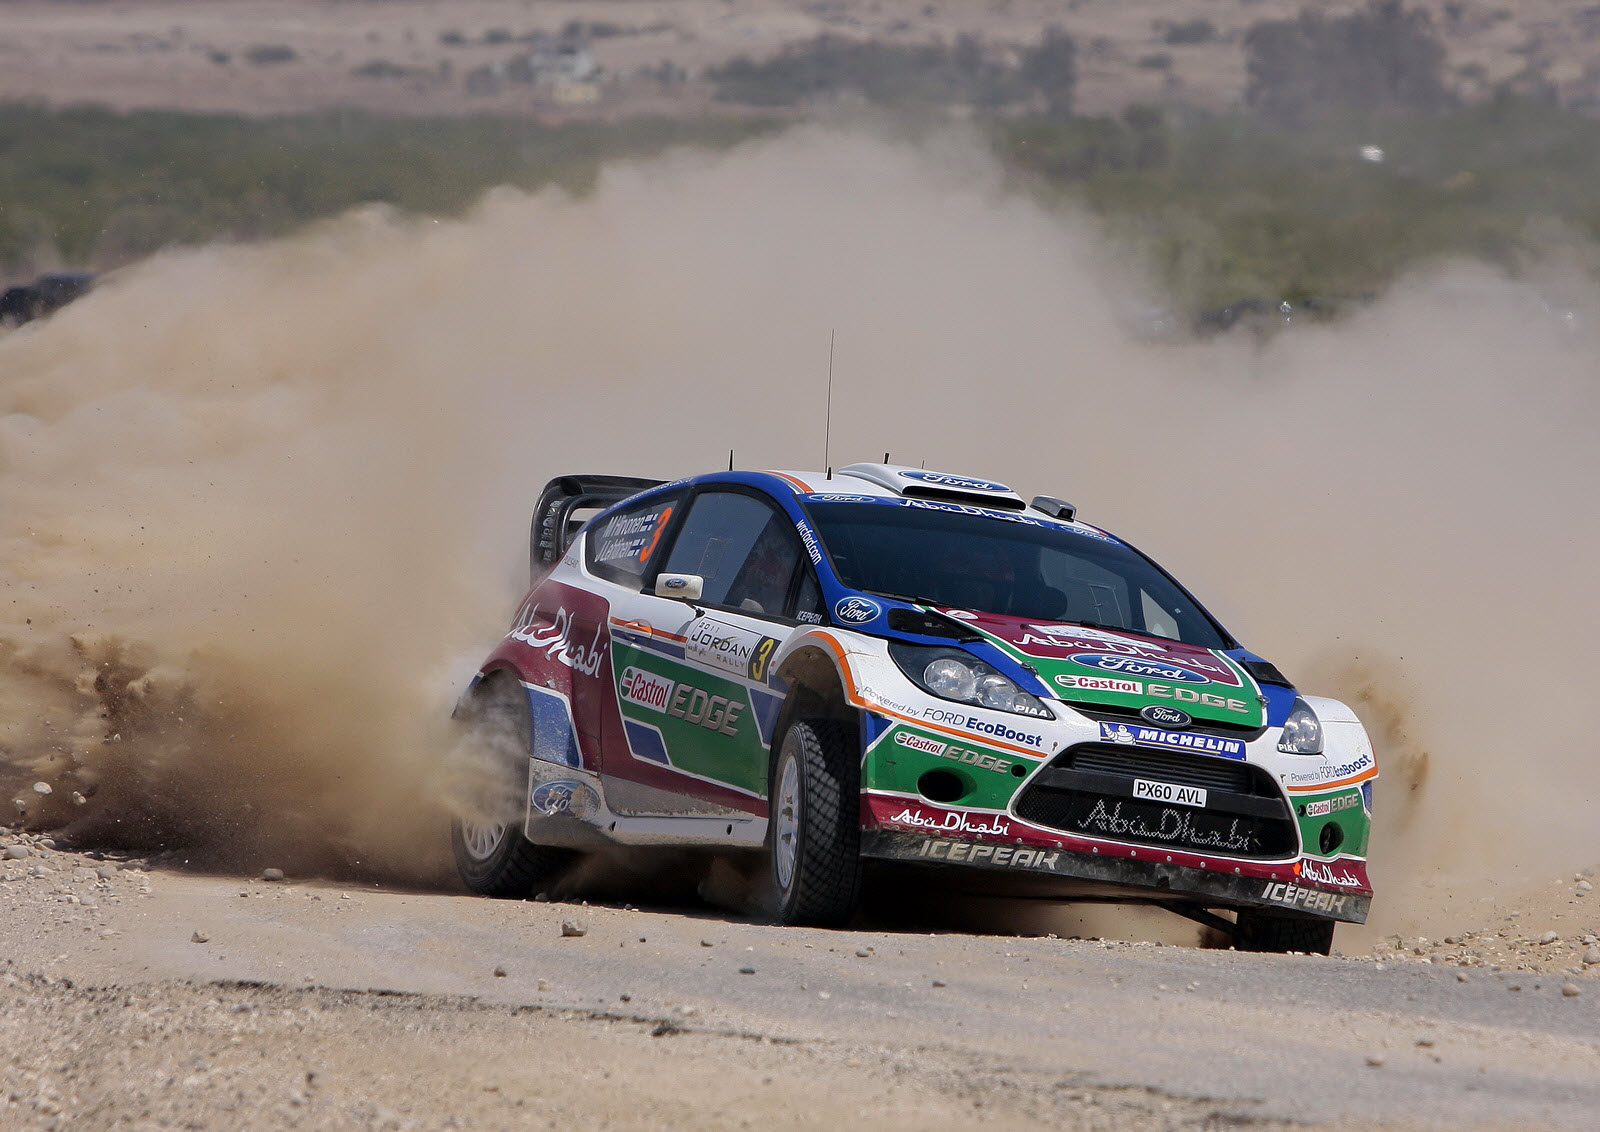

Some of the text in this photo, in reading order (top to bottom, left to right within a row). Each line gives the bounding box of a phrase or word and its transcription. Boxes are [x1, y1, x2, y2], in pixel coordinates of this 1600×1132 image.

[923, 472, 993, 490] Ford
[822, 494, 864, 502] Ford
[639, 507, 673, 563] 3
[795, 519, 823, 566] wrcford.com
[839, 599, 874, 621] Ford
[698, 621, 720, 633] 2011
[691, 630, 752, 659] JORDAN
[716, 653, 746, 668] RALLY
[752, 638, 775, 681] 3
[1098, 654, 1188, 681] Ford
[630, 673, 746, 737] Castrol EDGE
[1078, 677, 1250, 714] Castrol EDGE
[863, 686, 1043, 748] Powered by FORD EcoBoost
[1015, 704, 1048, 718] PIAA
[1153, 706, 1181, 723] Ford
[905, 735, 1013, 775] Castrol EDGE
[1138, 729, 1240, 754] MICHELIN
[1278, 743, 1299, 753] PIAA
[1291, 754, 1372, 782] Powered by FORD EcoBoost
[1136, 782, 1203, 805] PX60 AVL
[1313, 793, 1360, 815] Castrol EDGE
[918, 839, 1061, 870] ICEPEAK
[1262, 882, 1347, 913] ICEPEAK
